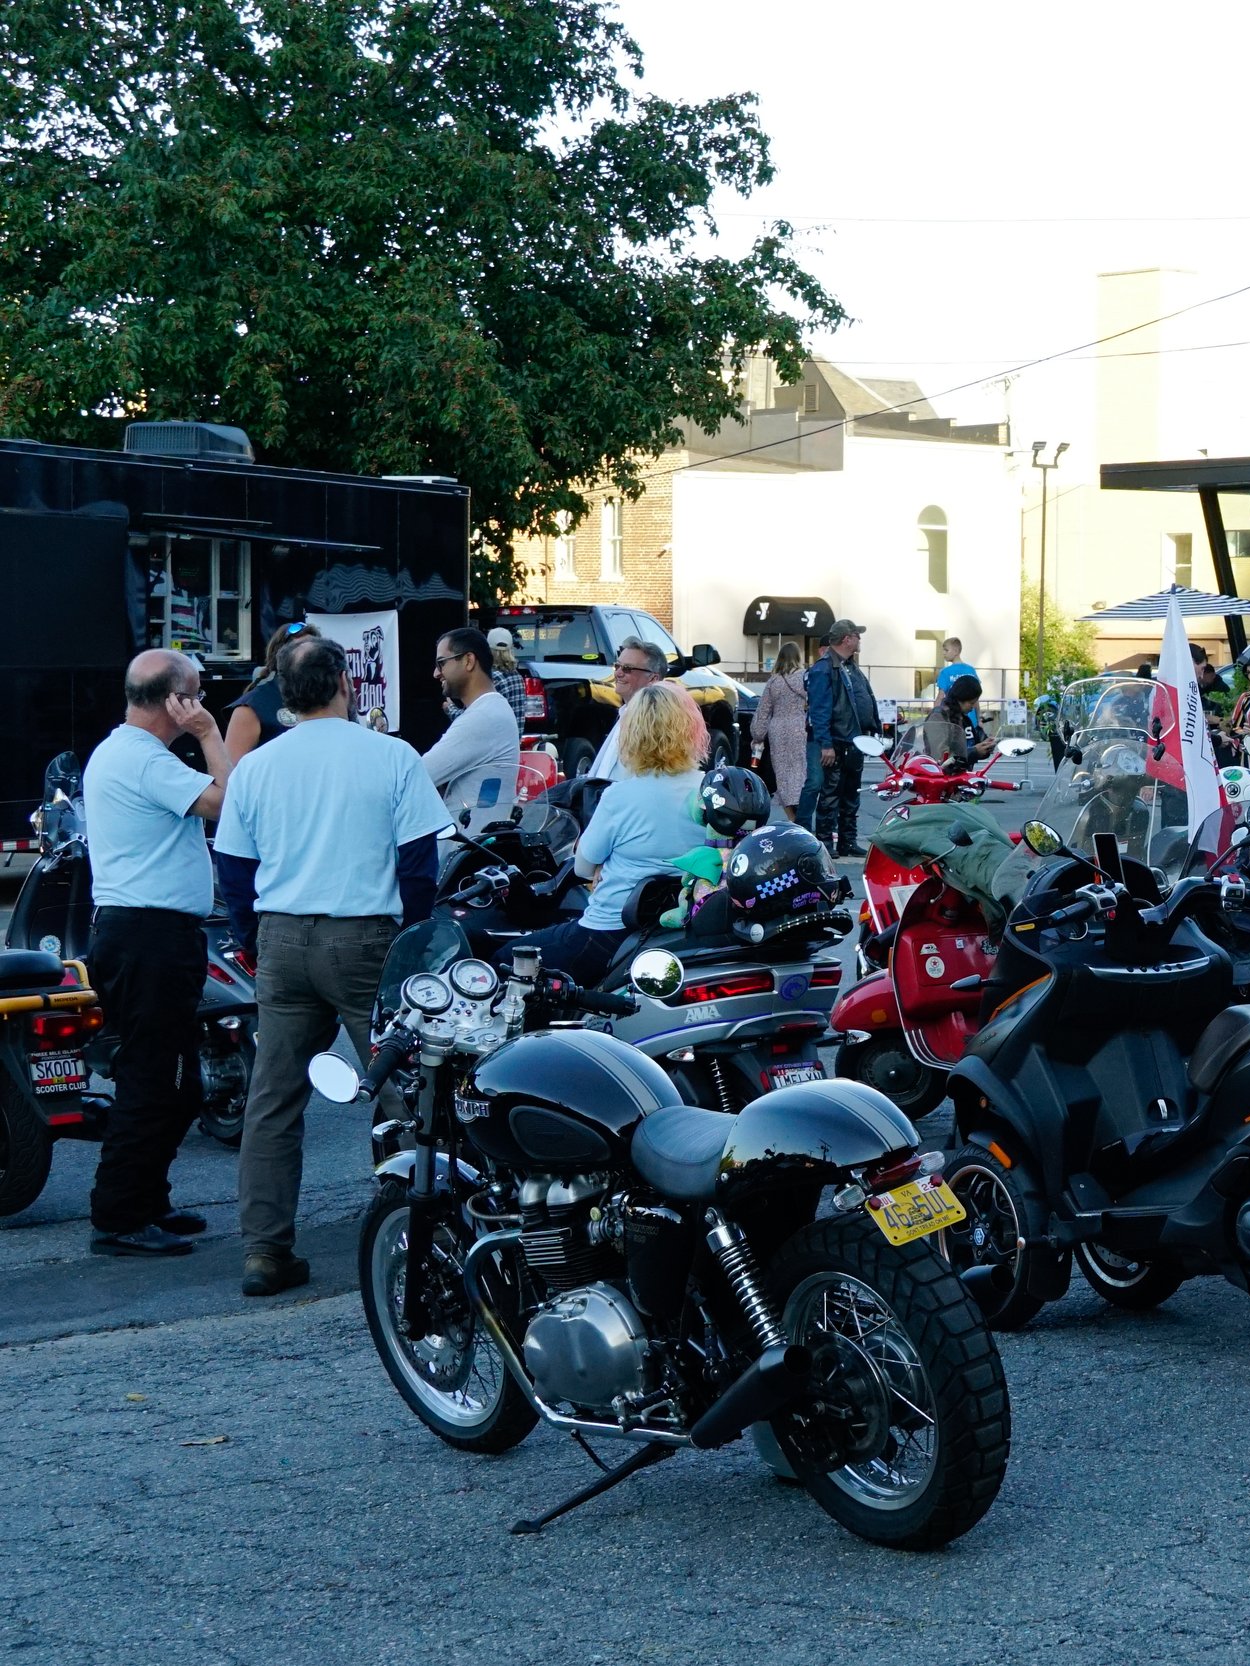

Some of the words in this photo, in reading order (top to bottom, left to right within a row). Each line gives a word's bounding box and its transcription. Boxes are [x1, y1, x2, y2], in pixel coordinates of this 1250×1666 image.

[684, 1004, 722, 1024] AMA
[35, 1060, 79, 1079] SKOOT
[35, 1083, 68, 1094] SCOOTER
[69, 1082, 87, 1090] CLUB
[900, 1190, 912, 1198] VA
